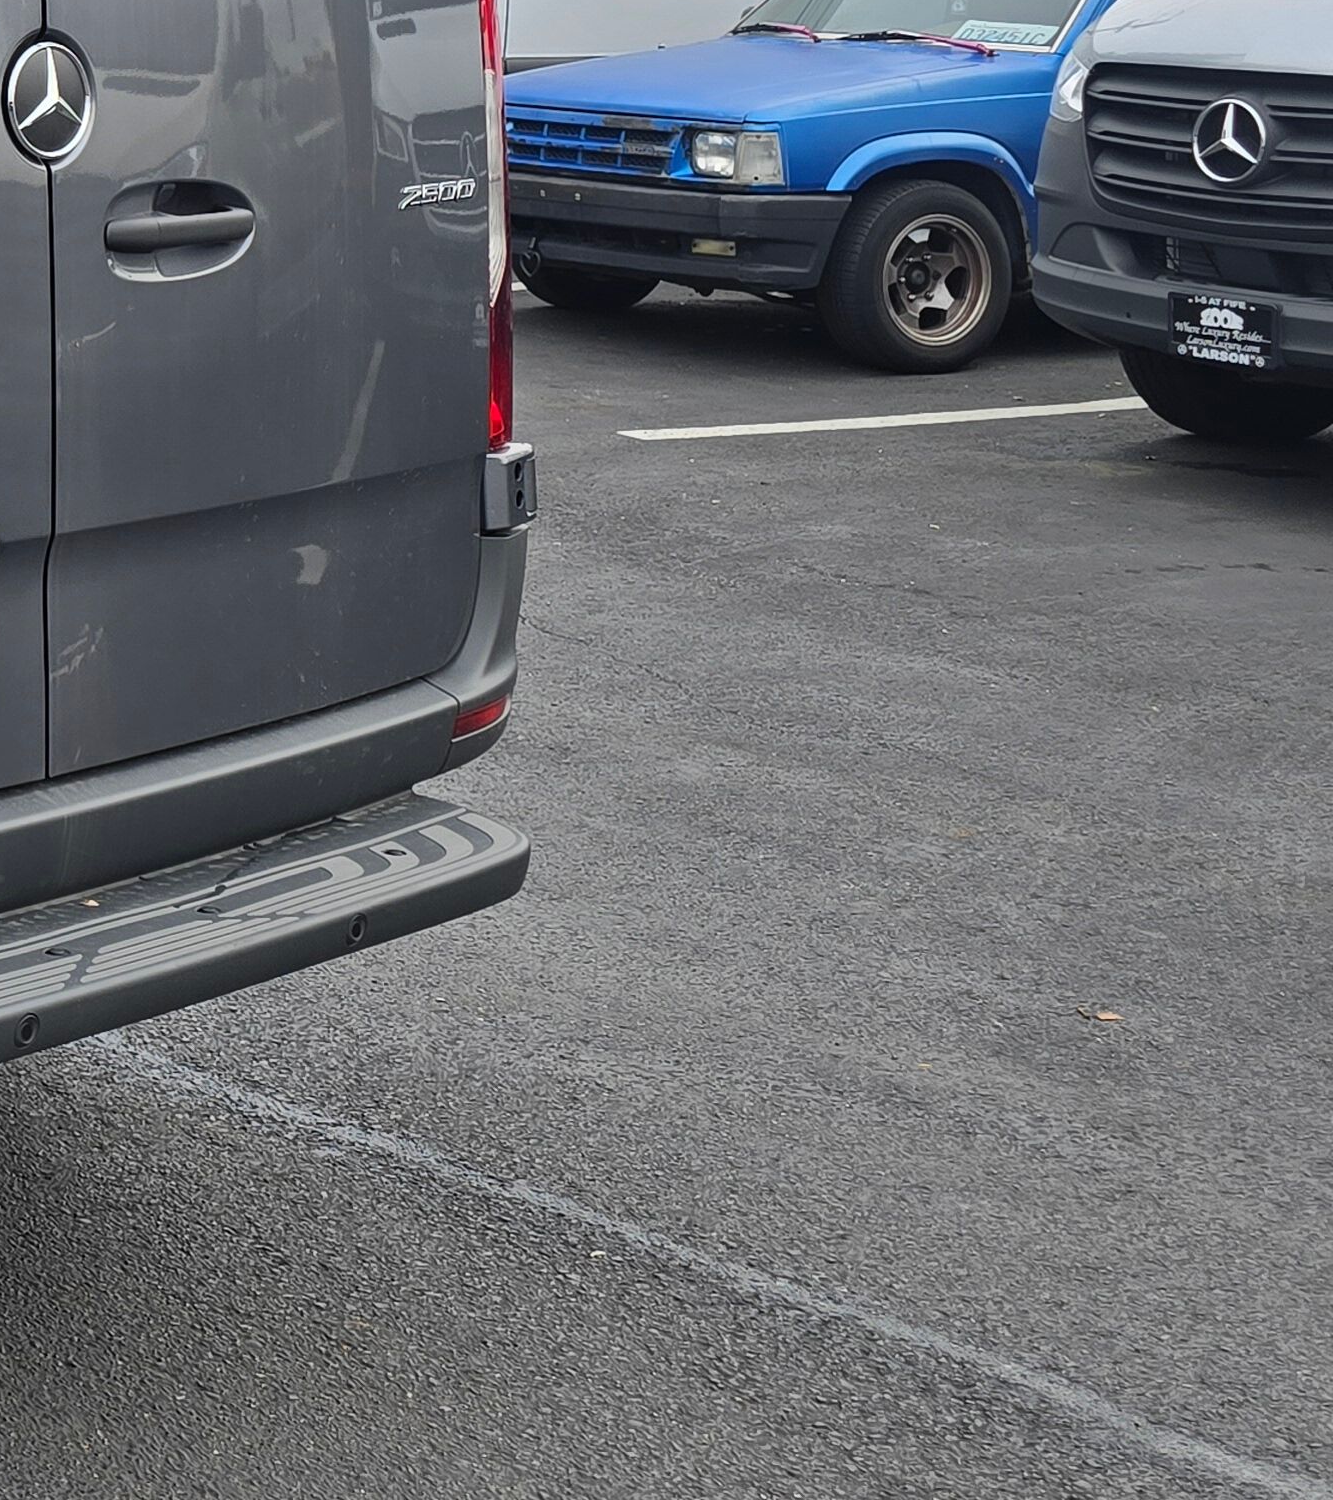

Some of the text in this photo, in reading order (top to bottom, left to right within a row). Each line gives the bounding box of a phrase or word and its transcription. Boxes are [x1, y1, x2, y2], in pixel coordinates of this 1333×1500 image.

[398, 178, 476, 210] 2500
[1174, 320, 1200, 336] Where
[1201, 327, 1231, 341] Luxury
[1192, 347, 1251, 366] LARSON
